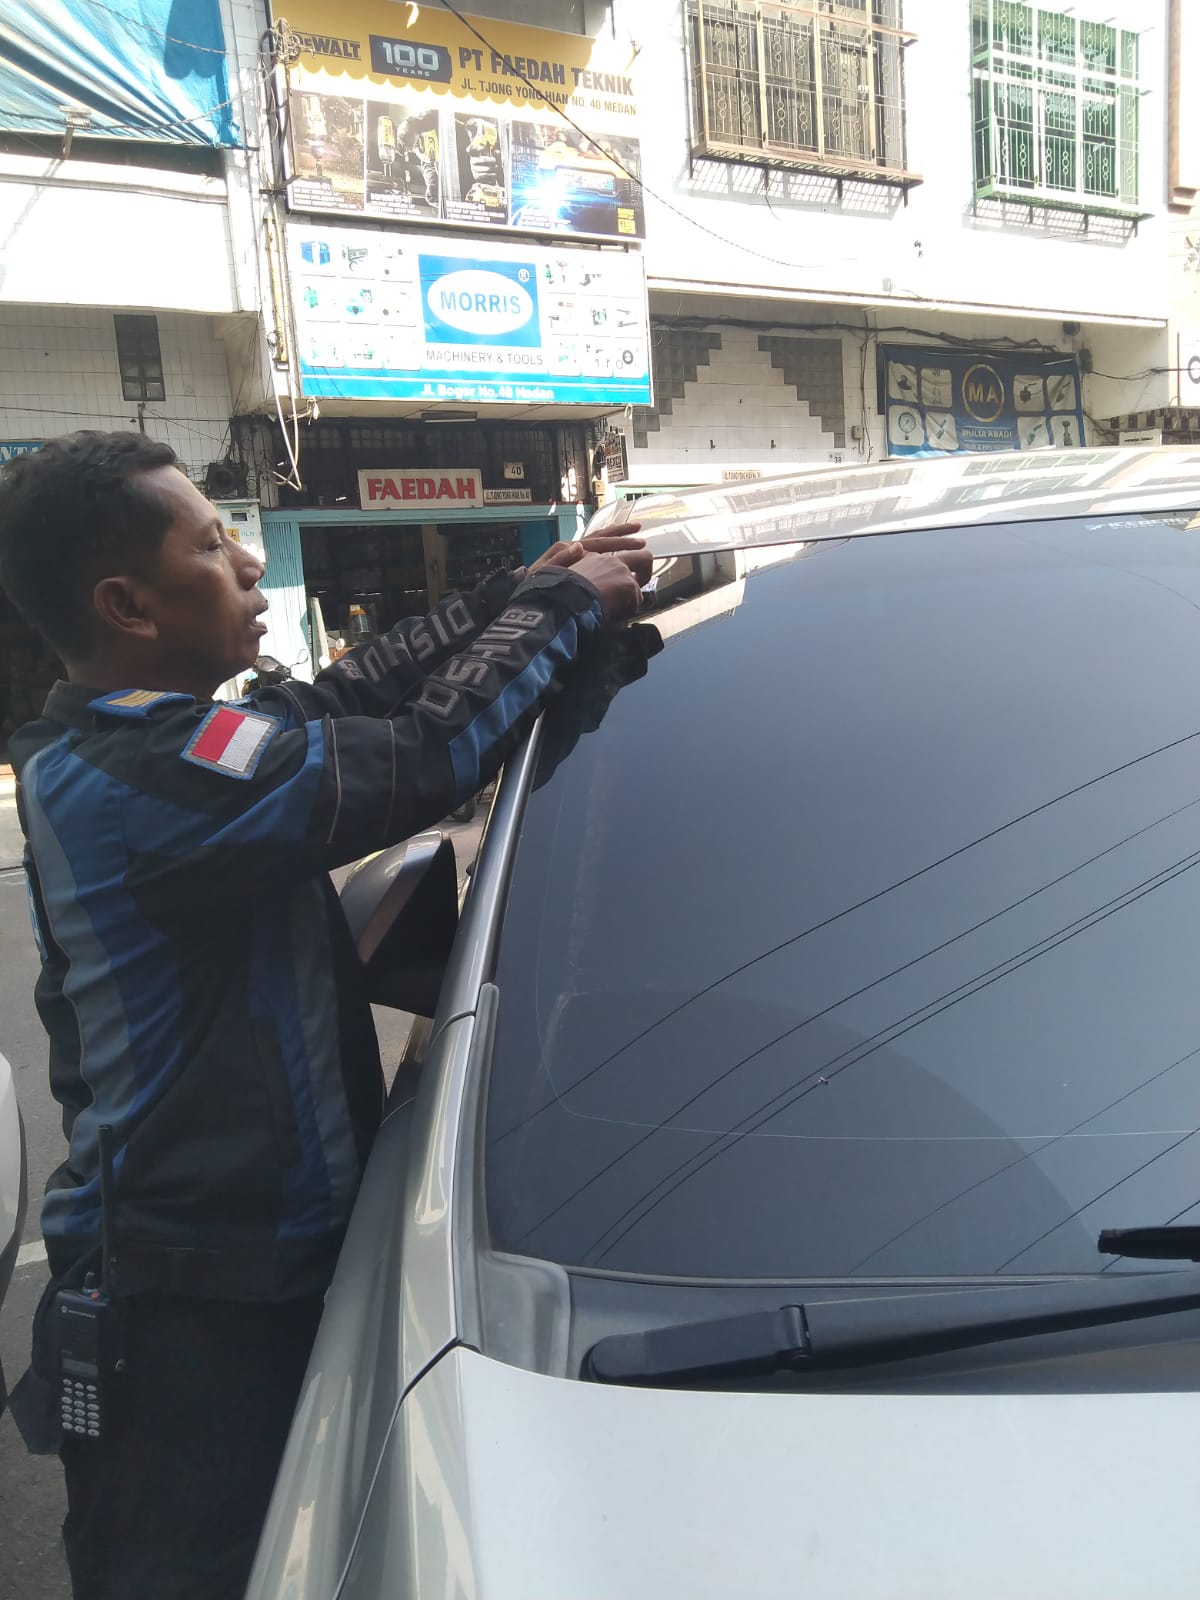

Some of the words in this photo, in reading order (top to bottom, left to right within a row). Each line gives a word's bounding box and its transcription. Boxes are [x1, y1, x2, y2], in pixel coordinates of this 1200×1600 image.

[383, 42, 439, 71] 100
[395, 67, 430, 77] YEARS
[459, 47, 483, 71] PT
[491, 52, 566, 85] FAEDAH
[571, 67, 634, 97] TEKNIK
[461, 78, 477, 91] JL.
[479, 80, 512, 96] TJONG
[515, 86, 543, 101] YONG
[545, 91, 569, 105] HIAN
[590, 99, 601, 109] 40
[604, 101, 637, 116] MEDAN
[440, 291, 521, 315] MORRIS
[426, 350, 493, 364] MACHINERY
[496, 353, 504, 364] &
[507, 353, 544, 366] TOOLS
[968, 382, 998, 403] MA
[988, 430, 1012, 439] ABADI
[511, 466, 522, 476] 40
[367, 478, 476, 501] FAEDAH
